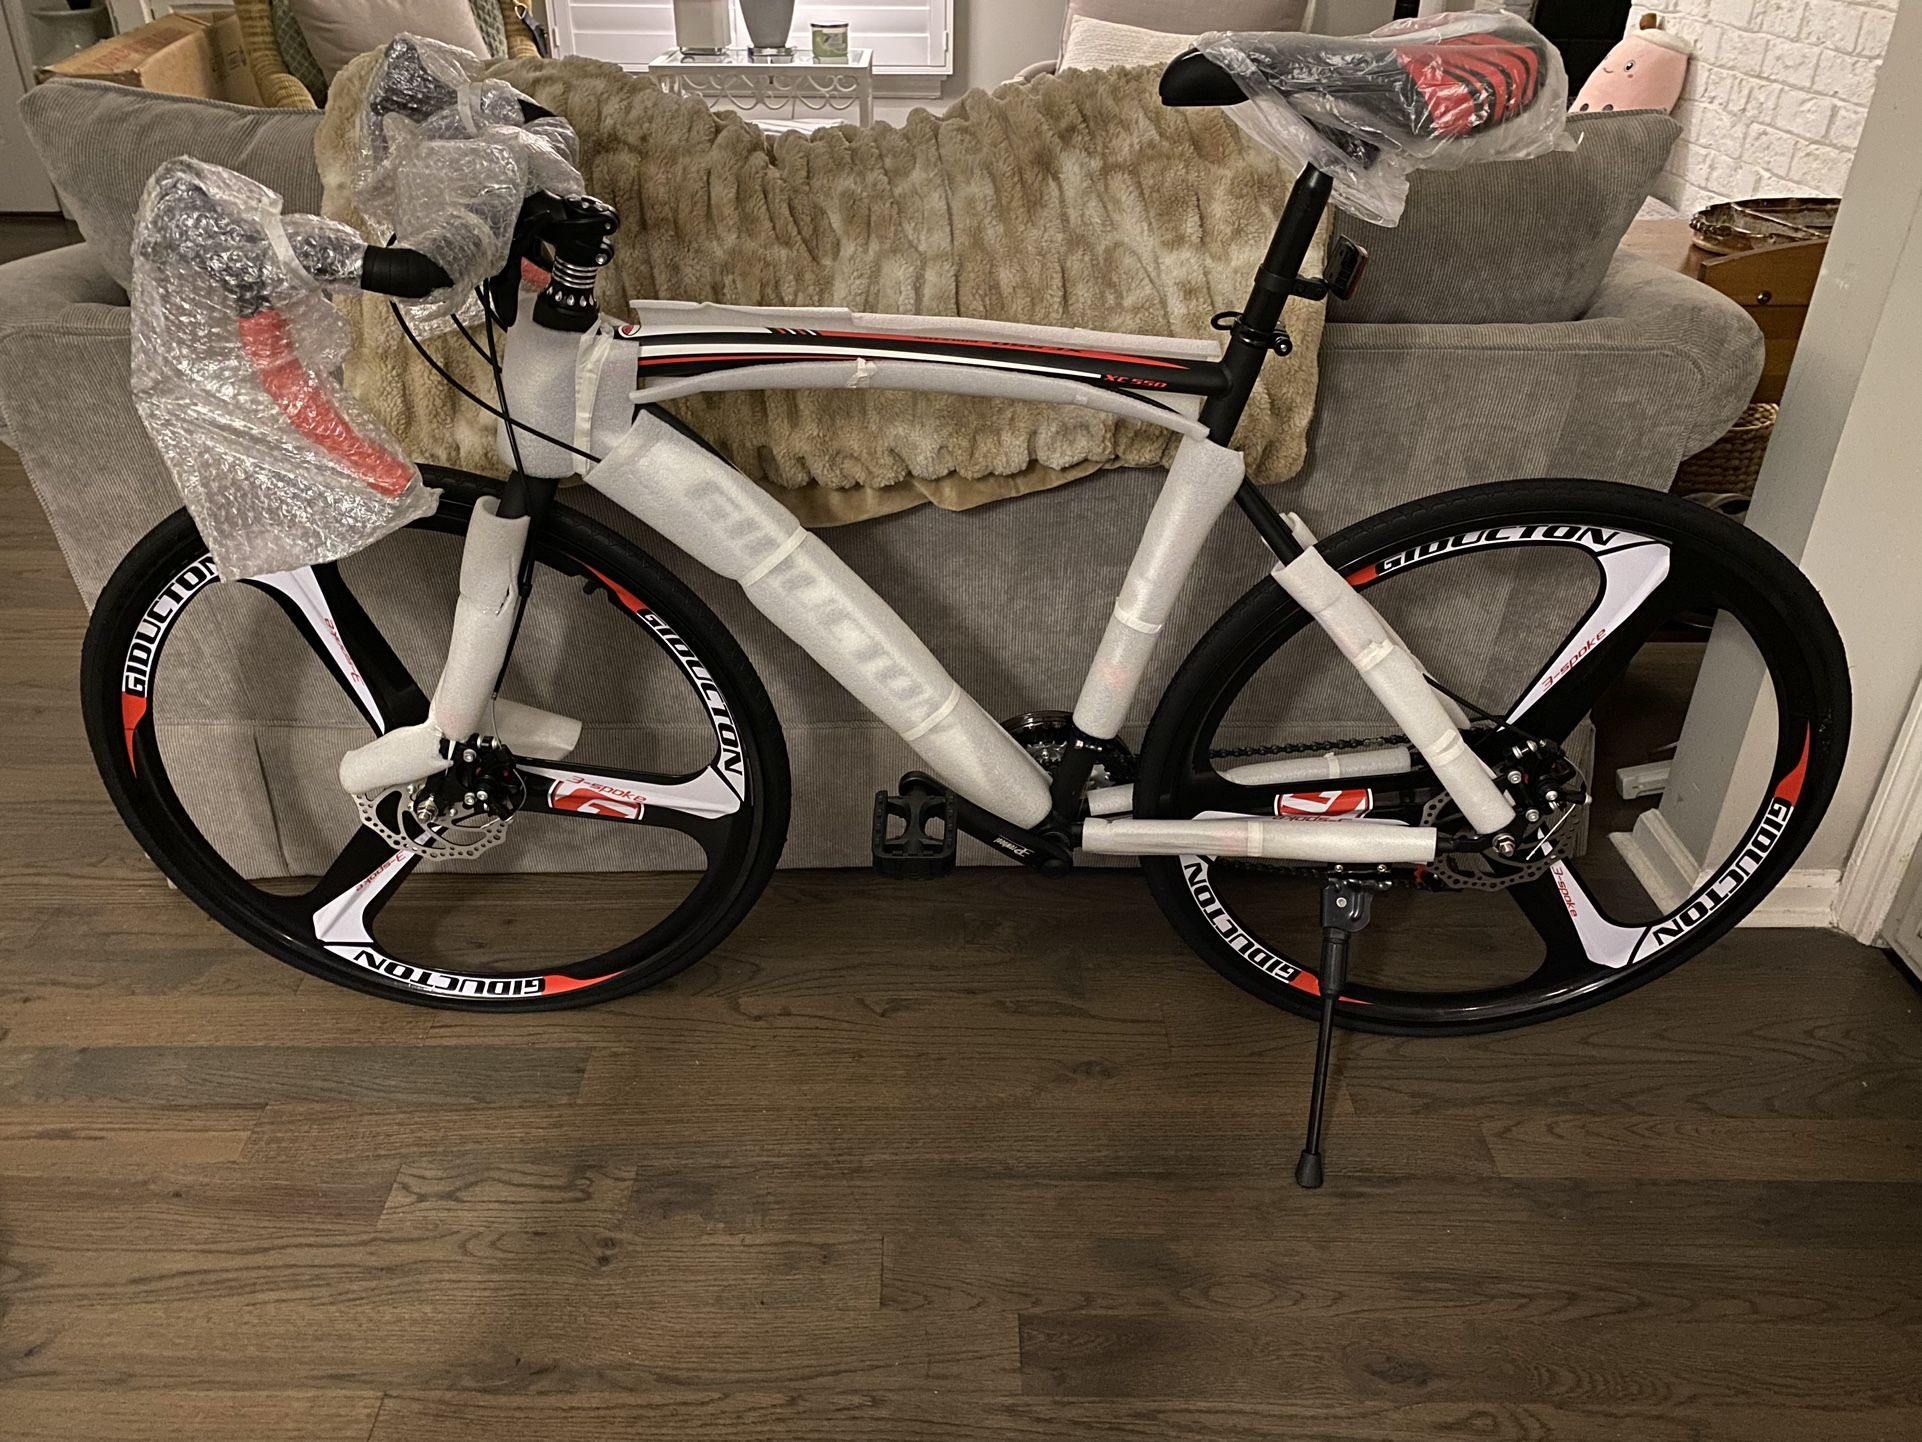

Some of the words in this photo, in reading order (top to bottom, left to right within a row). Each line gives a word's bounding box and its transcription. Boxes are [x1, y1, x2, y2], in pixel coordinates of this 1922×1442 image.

[1103, 373, 1129, 384] XC
[1131, 377, 1168, 389] 550
[1374, 524, 1620, 576] GIDUCTON
[1541, 628, 1606, 691] 3-spoke
[637, 608, 743, 776] GIDUCTON
[566, 775, 647, 802] 3-spoke
[356, 853, 406, 892] 3-spoke
[1551, 866, 1577, 918] 3-spoke
[1652, 796, 1793, 946] GIDUCTON
[1184, 862, 1303, 983] GIDUCTON
[353, 950, 546, 996] GIDUCTON
